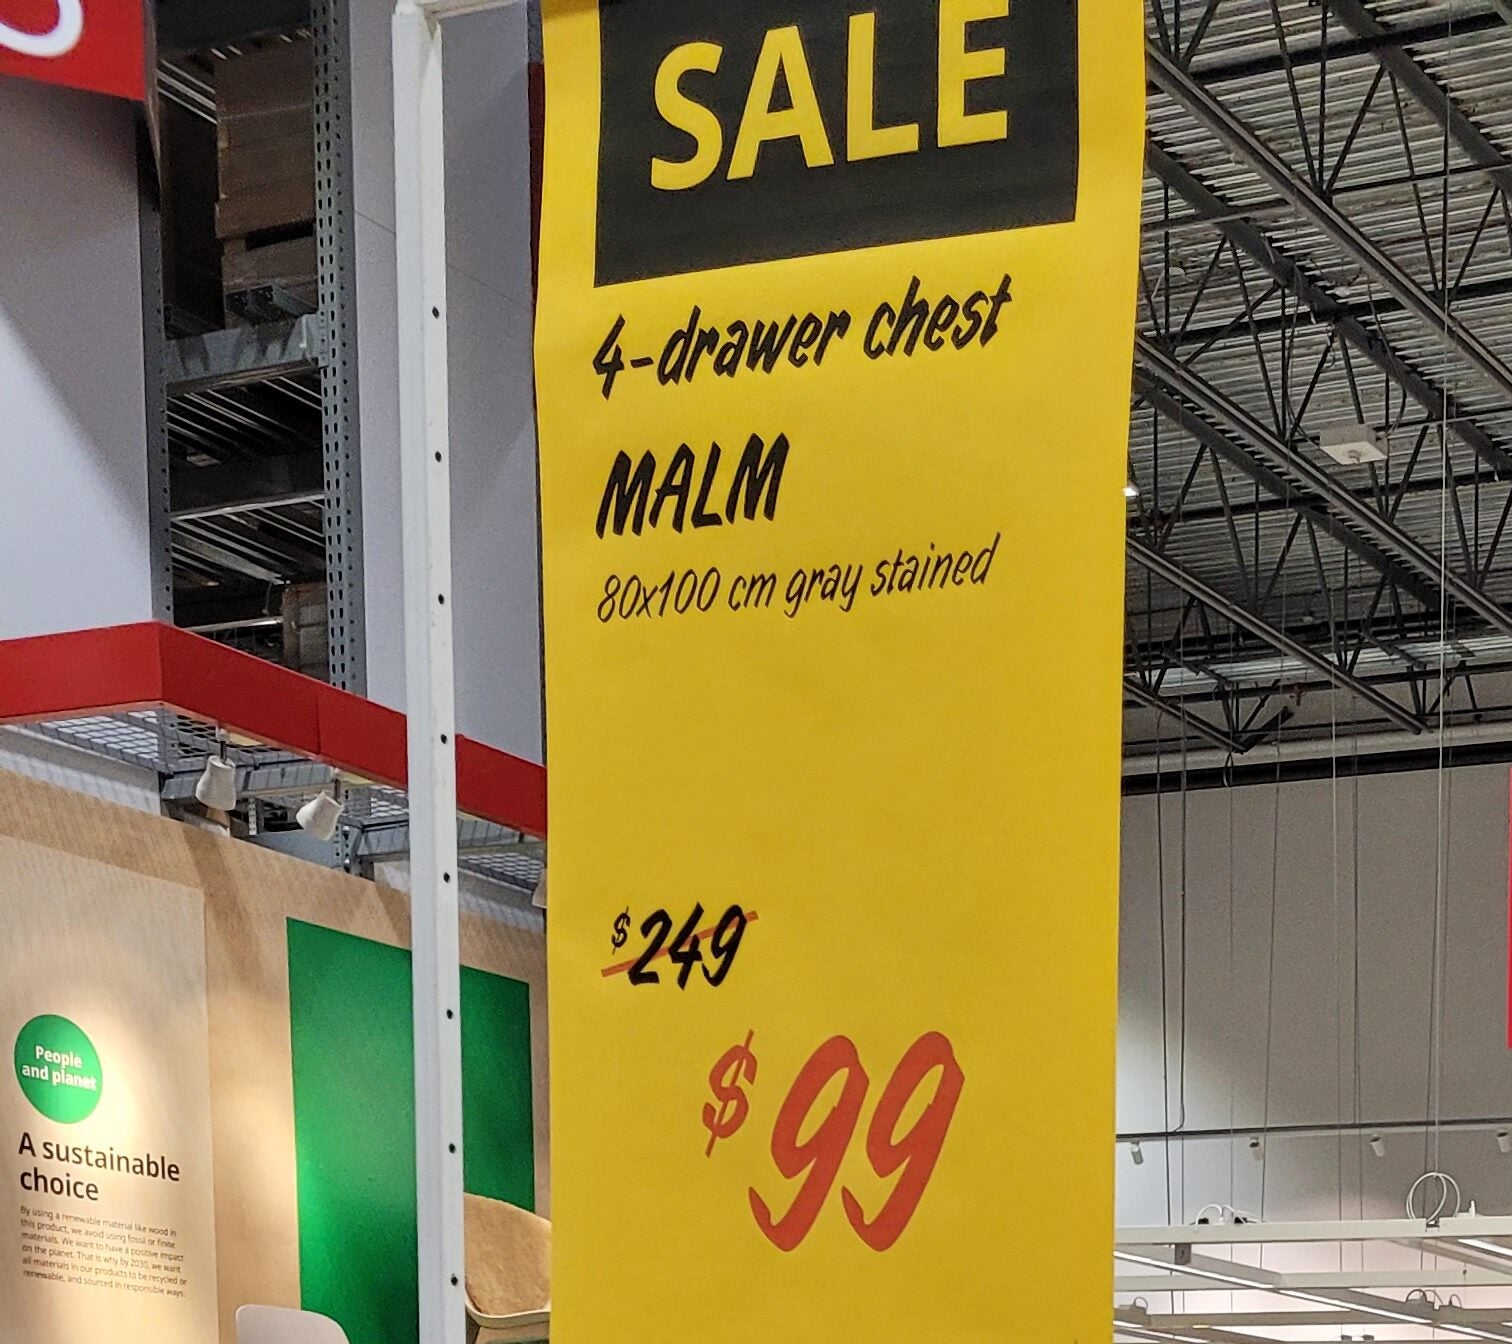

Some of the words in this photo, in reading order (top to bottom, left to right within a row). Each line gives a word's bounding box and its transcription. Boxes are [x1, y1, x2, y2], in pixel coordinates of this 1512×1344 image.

[650, 0, 1010, 191] SALE
[592, 304, 852, 401] 4-drawer
[863, 273, 1013, 360] chest
[595, 432, 790, 540] MALM
[596, 566, 722, 623] 80x100
[728, 572, 777, 610] cm
[784, 564, 864, 620] gray
[870, 531, 1002, 598] stained
[610, 901, 748, 992] $249
[22, 1063, 49, 1081] and
[52, 1069, 98, 1092] planet
[35, 1045, 83, 1069] People
[18, 1131, 37, 1158] A
[42, 1140, 181, 1182] sustainable
[20, 1166, 99, 1202] choice
[702, 1029, 965, 1253] $99
